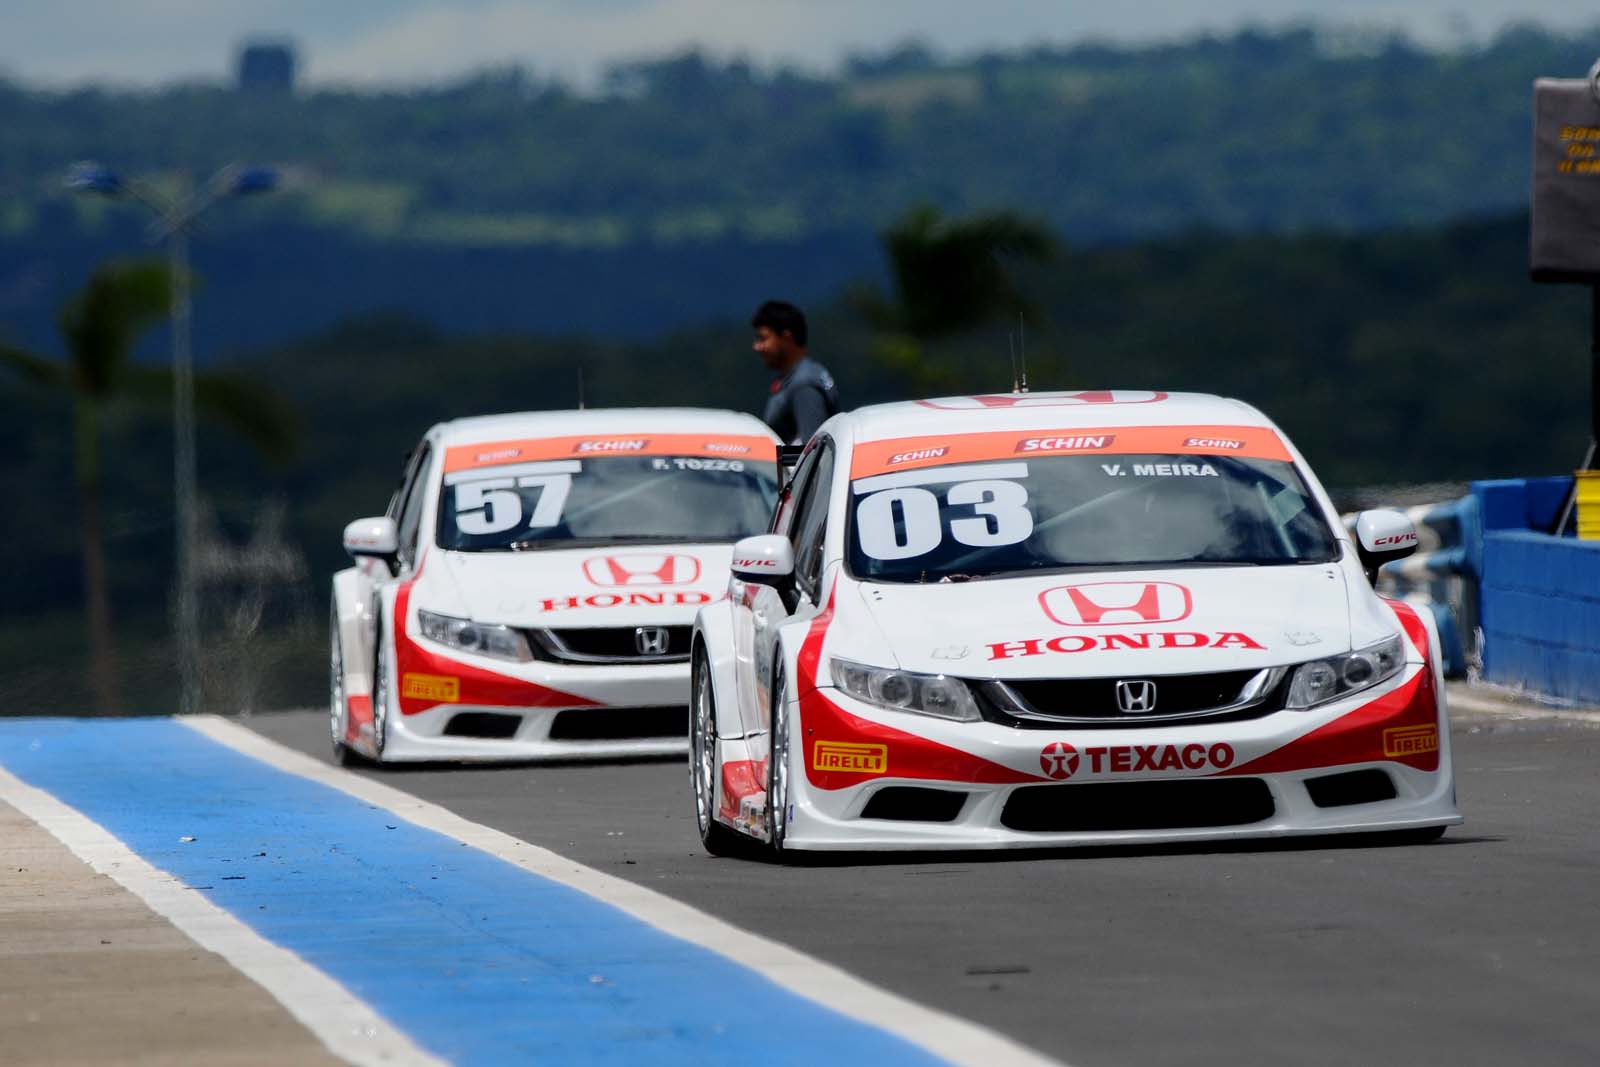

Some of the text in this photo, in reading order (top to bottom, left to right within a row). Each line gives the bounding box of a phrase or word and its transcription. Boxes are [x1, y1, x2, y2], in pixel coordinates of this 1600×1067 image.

[579, 440, 643, 451] SCHIN
[1023, 437, 1105, 450] SCHIN
[1187, 438, 1240, 449] SCHIN
[892, 447, 945, 464] SCHIN
[676, 459, 745, 473] TOZZO
[1102, 464, 1219, 477] V. MEIRA
[455, 474, 573, 535] 57
[856, 480, 1034, 561] 03
[985, 632, 1269, 661] HONDA
[816, 744, 884, 770] PIRELLI
[1085, 742, 1235, 773] TEXACO
